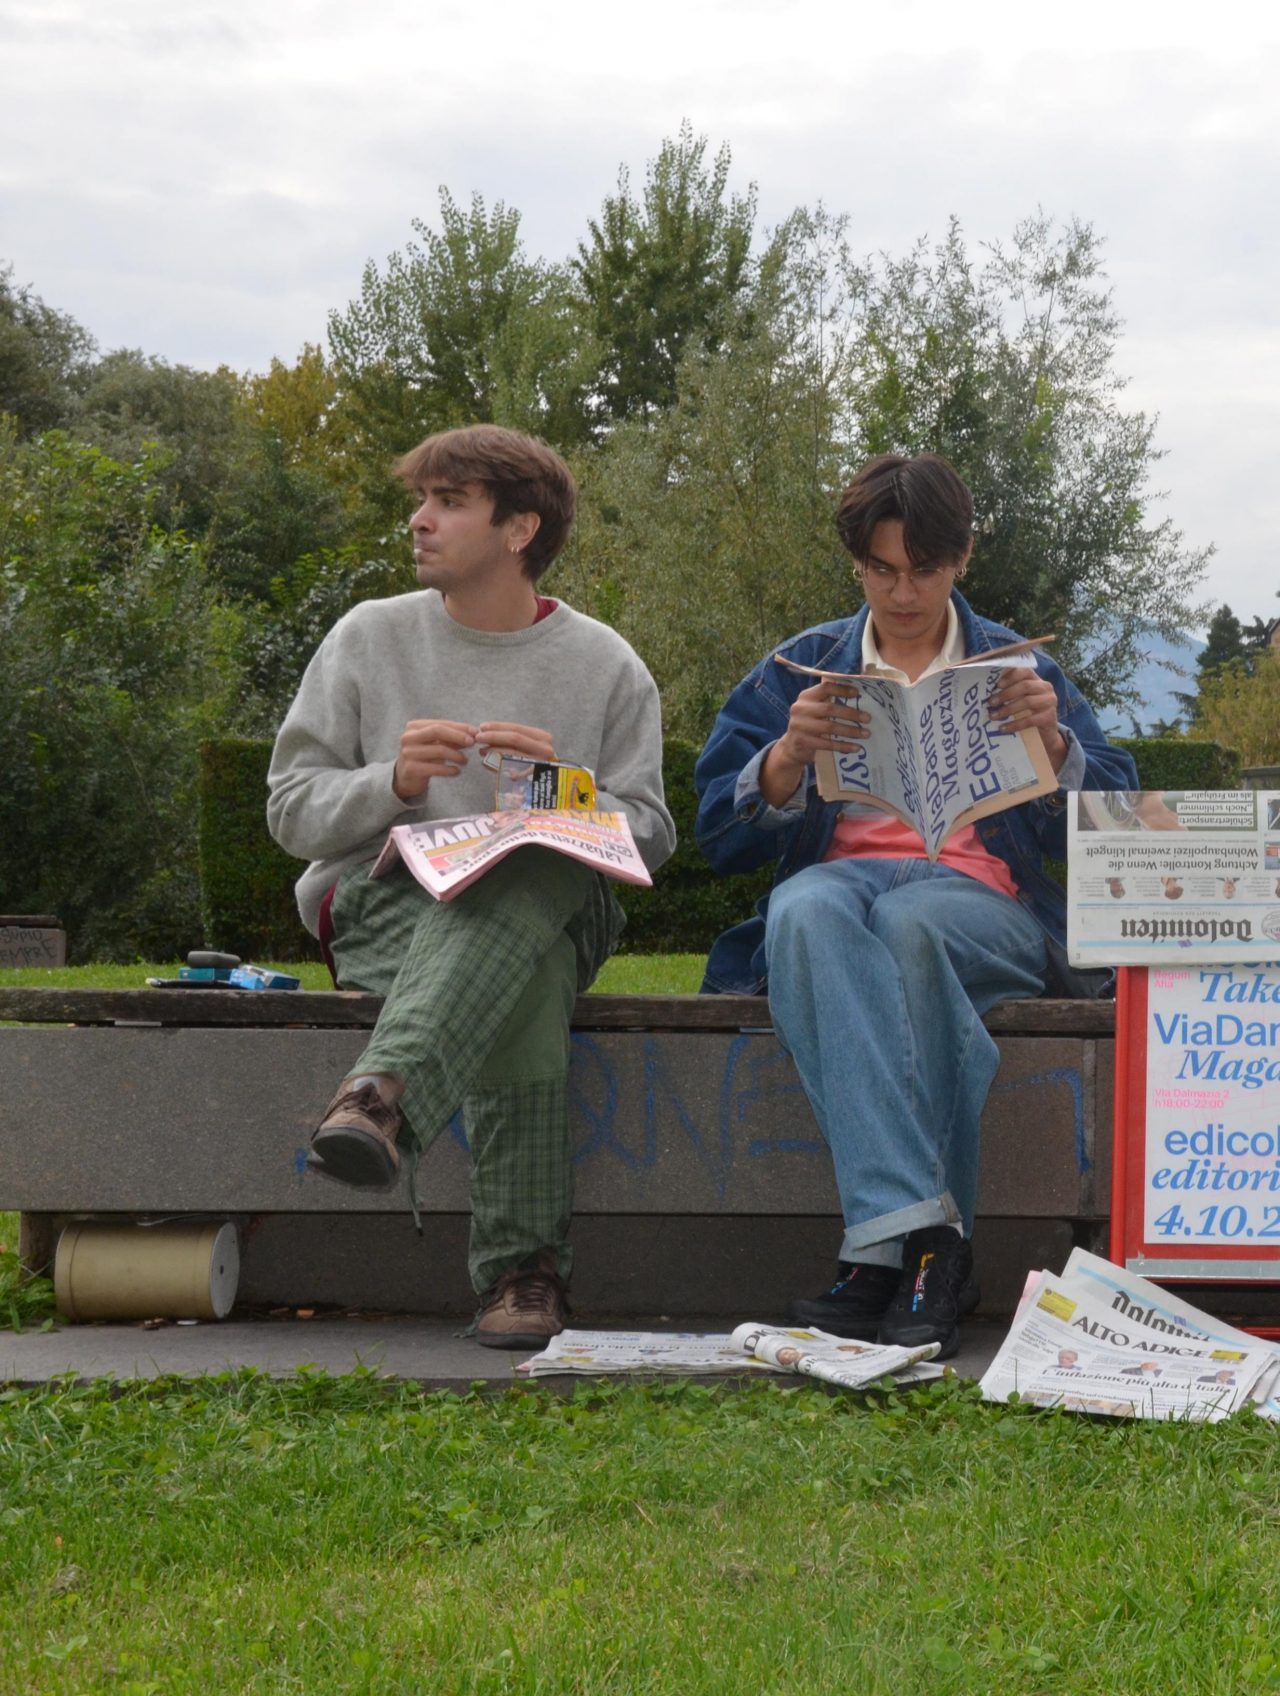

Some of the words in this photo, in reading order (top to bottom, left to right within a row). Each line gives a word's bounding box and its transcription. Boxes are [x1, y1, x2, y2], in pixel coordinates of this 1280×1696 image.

[964, 681, 1001, 802] Edicola
[920, 704, 945, 848] ViaDante
[1179, 815, 1253, 826] Schülertransport:
[1086, 845, 1126, 858] klingelt
[1128, 847, 1171, 858] zweimal
[1173, 846, 1258, 858] Wohnbaupolizei
[1108, 860, 1125, 871] die
[1127, 860, 1158, 870] Wenn
[1160, 860, 1211, 871] Kontrolle:
[1215, 859, 1258, 871] Achtung
[1120, 918, 1254, 943] Dolomiten
[1155, 1088, 1171, 1097] Via
[1173, 1088, 1220, 1098] Dalmazia
[1072, 1315, 1130, 1347] ALTO
[1131, 1340, 1210, 1359] ADIGE
